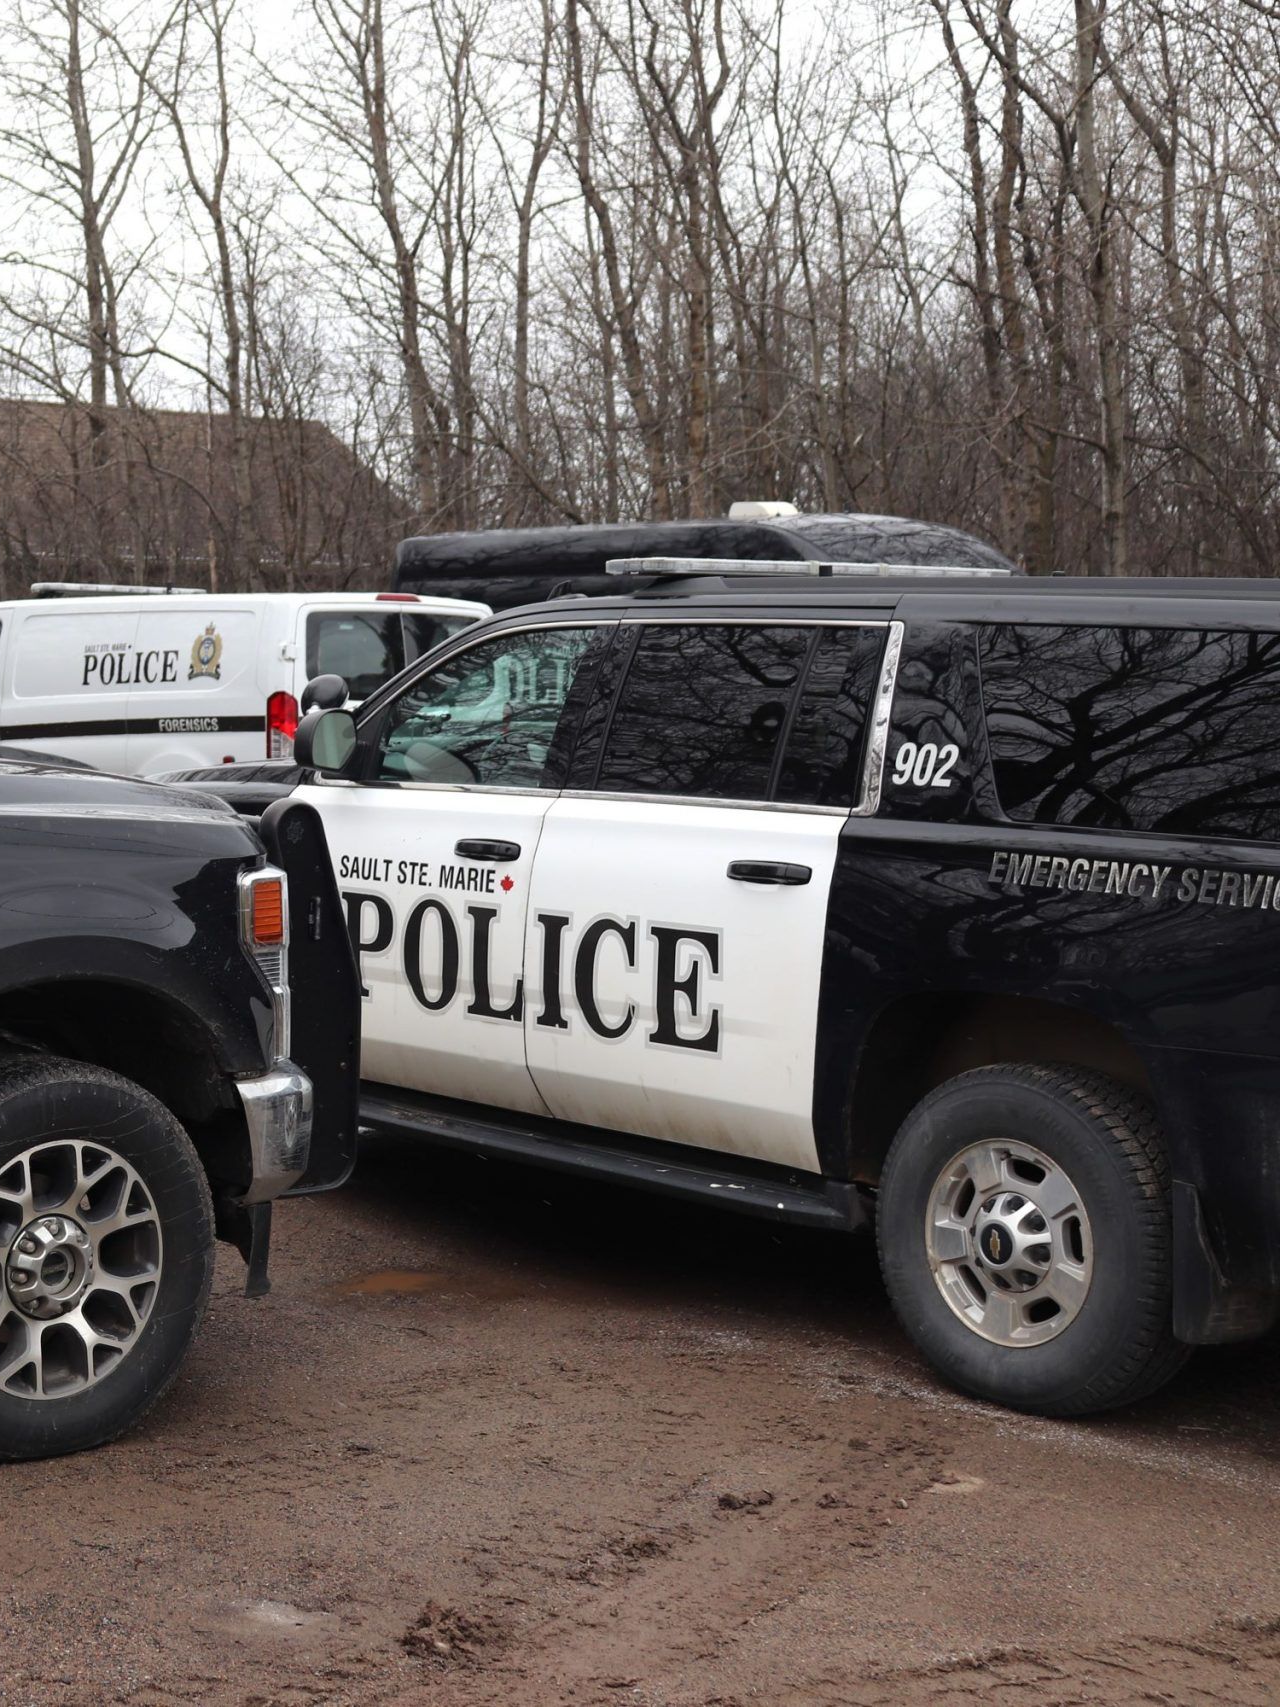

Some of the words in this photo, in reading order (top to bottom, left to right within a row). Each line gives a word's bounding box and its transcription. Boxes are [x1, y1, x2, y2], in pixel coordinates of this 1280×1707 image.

[82, 651, 178, 685] POLICE
[158, 717, 219, 732] FORENSICS
[891, 741, 960, 788] 902
[339, 854, 394, 883] SAULT
[397, 860, 432, 887] STE.
[438, 864, 497, 894] MARIE
[986, 850, 1172, 899] EMERGENCY
[340, 890, 721, 1054] POLICE
